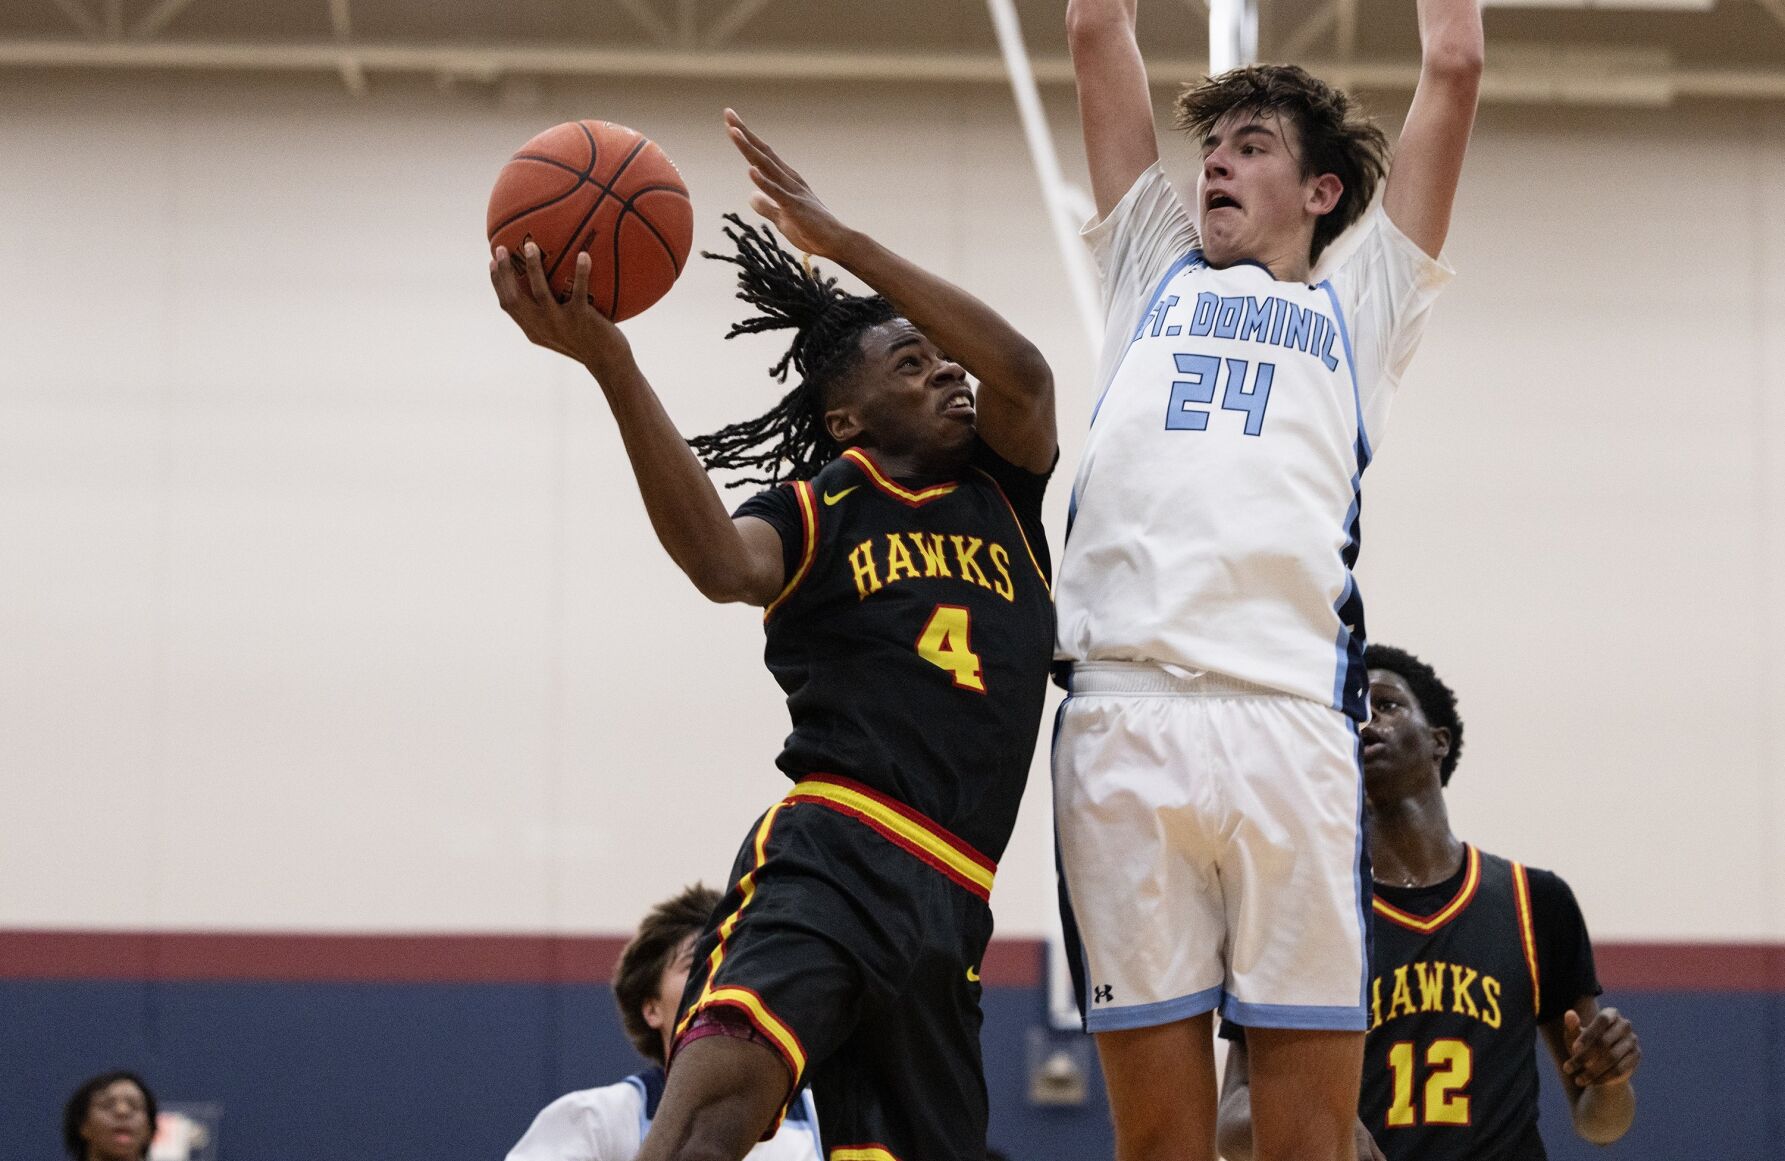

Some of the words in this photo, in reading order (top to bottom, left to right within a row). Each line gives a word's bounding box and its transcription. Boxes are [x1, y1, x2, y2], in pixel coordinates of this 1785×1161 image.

[1165, 353, 1275, 437] 24
[848, 531, 1015, 602] HAWKS
[914, 603, 988, 695] 4
[1385, 1037, 1473, 1129] 12
